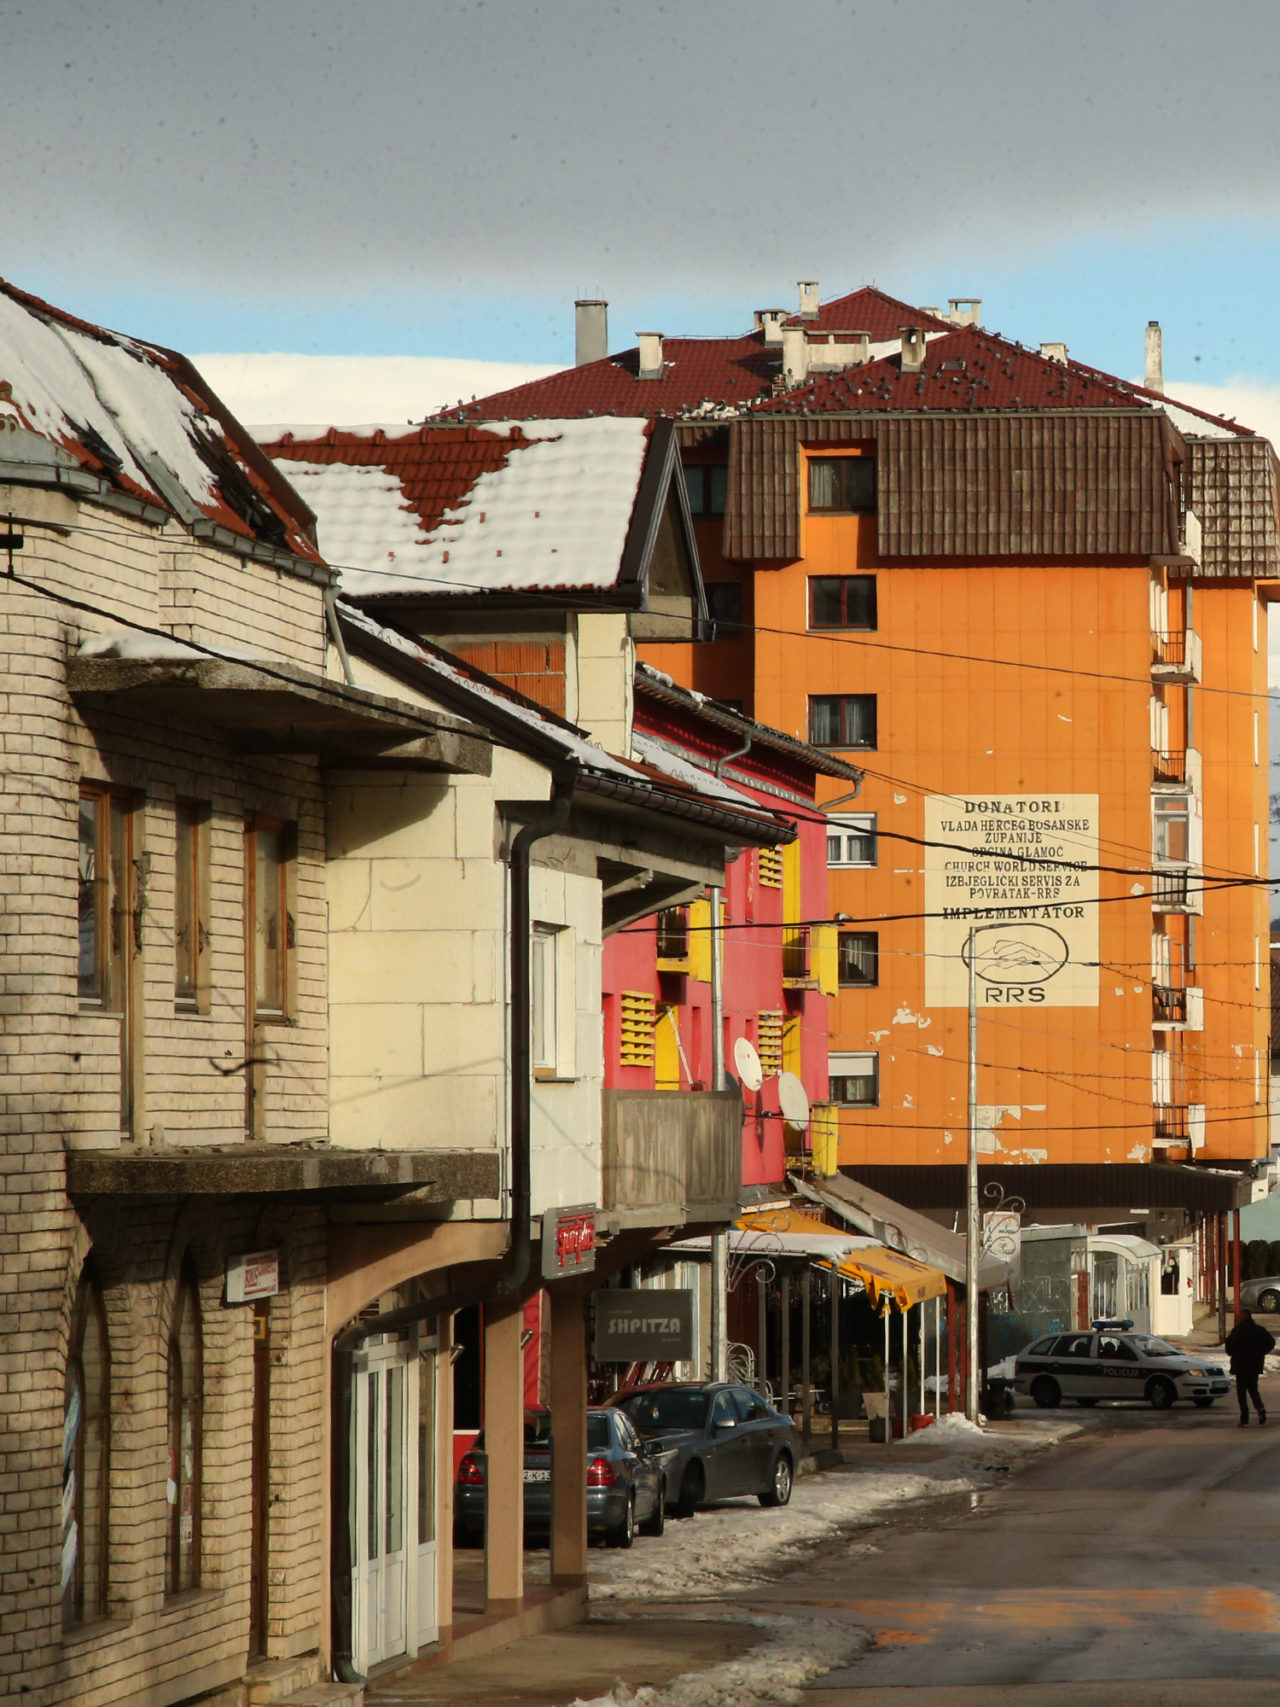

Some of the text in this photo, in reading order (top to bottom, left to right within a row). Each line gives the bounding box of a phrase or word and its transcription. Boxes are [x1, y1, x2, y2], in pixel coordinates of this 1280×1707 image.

[941, 819, 1089, 831] VLADA HERCEG BOSANSKE
[945, 861, 990, 872] CHURCH
[994, 861, 1036, 872] WORLD
[1021, 875, 1062, 887] SERVIS
[1065, 875, 1080, 887] ZA
[943, 906, 1085, 919] IMPLEMENTATOR
[986, 987, 1045, 1003] RRS
[608, 1318, 681, 1334] SHPITZA
[1103, 1367, 1140, 1377] POLICIJA
